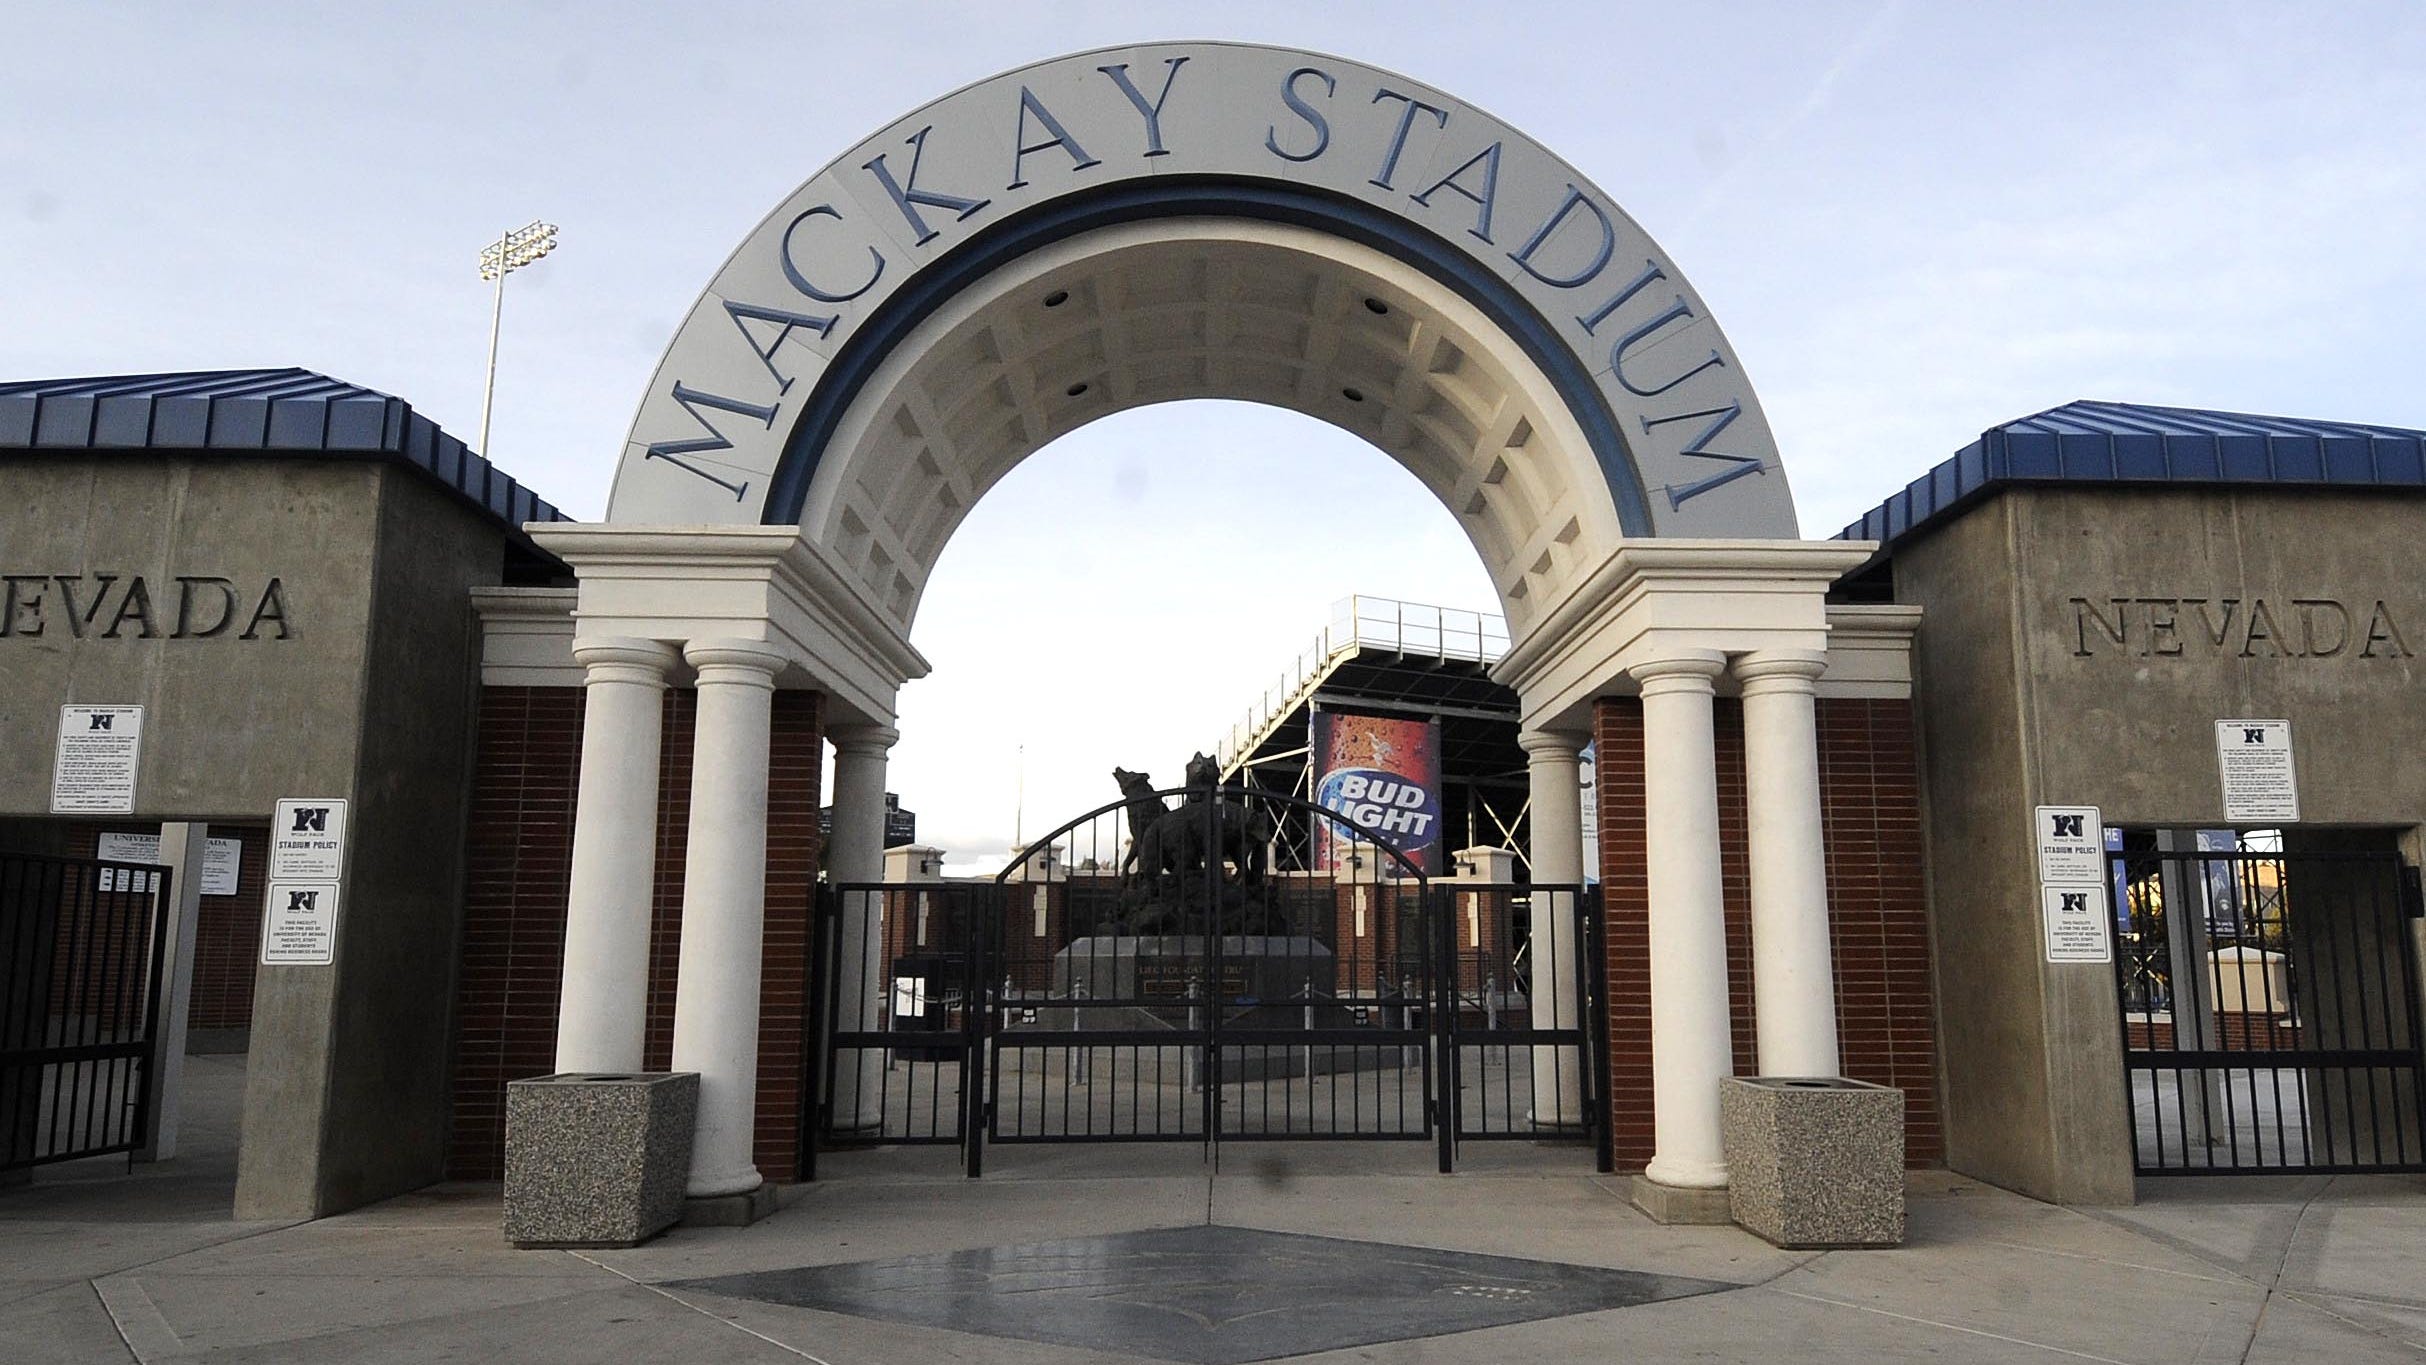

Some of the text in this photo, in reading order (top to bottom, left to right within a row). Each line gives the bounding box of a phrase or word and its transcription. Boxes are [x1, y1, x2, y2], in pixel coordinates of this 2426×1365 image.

[645, 57, 1765, 512] MACKAY STADIUM
[2069, 597, 2415, 658] NEVADA
[1341, 775, 1425, 809] BUD
[278, 841, 337, 849] STADIUM POLICY
[2075, 846, 2096, 854] POLICY
